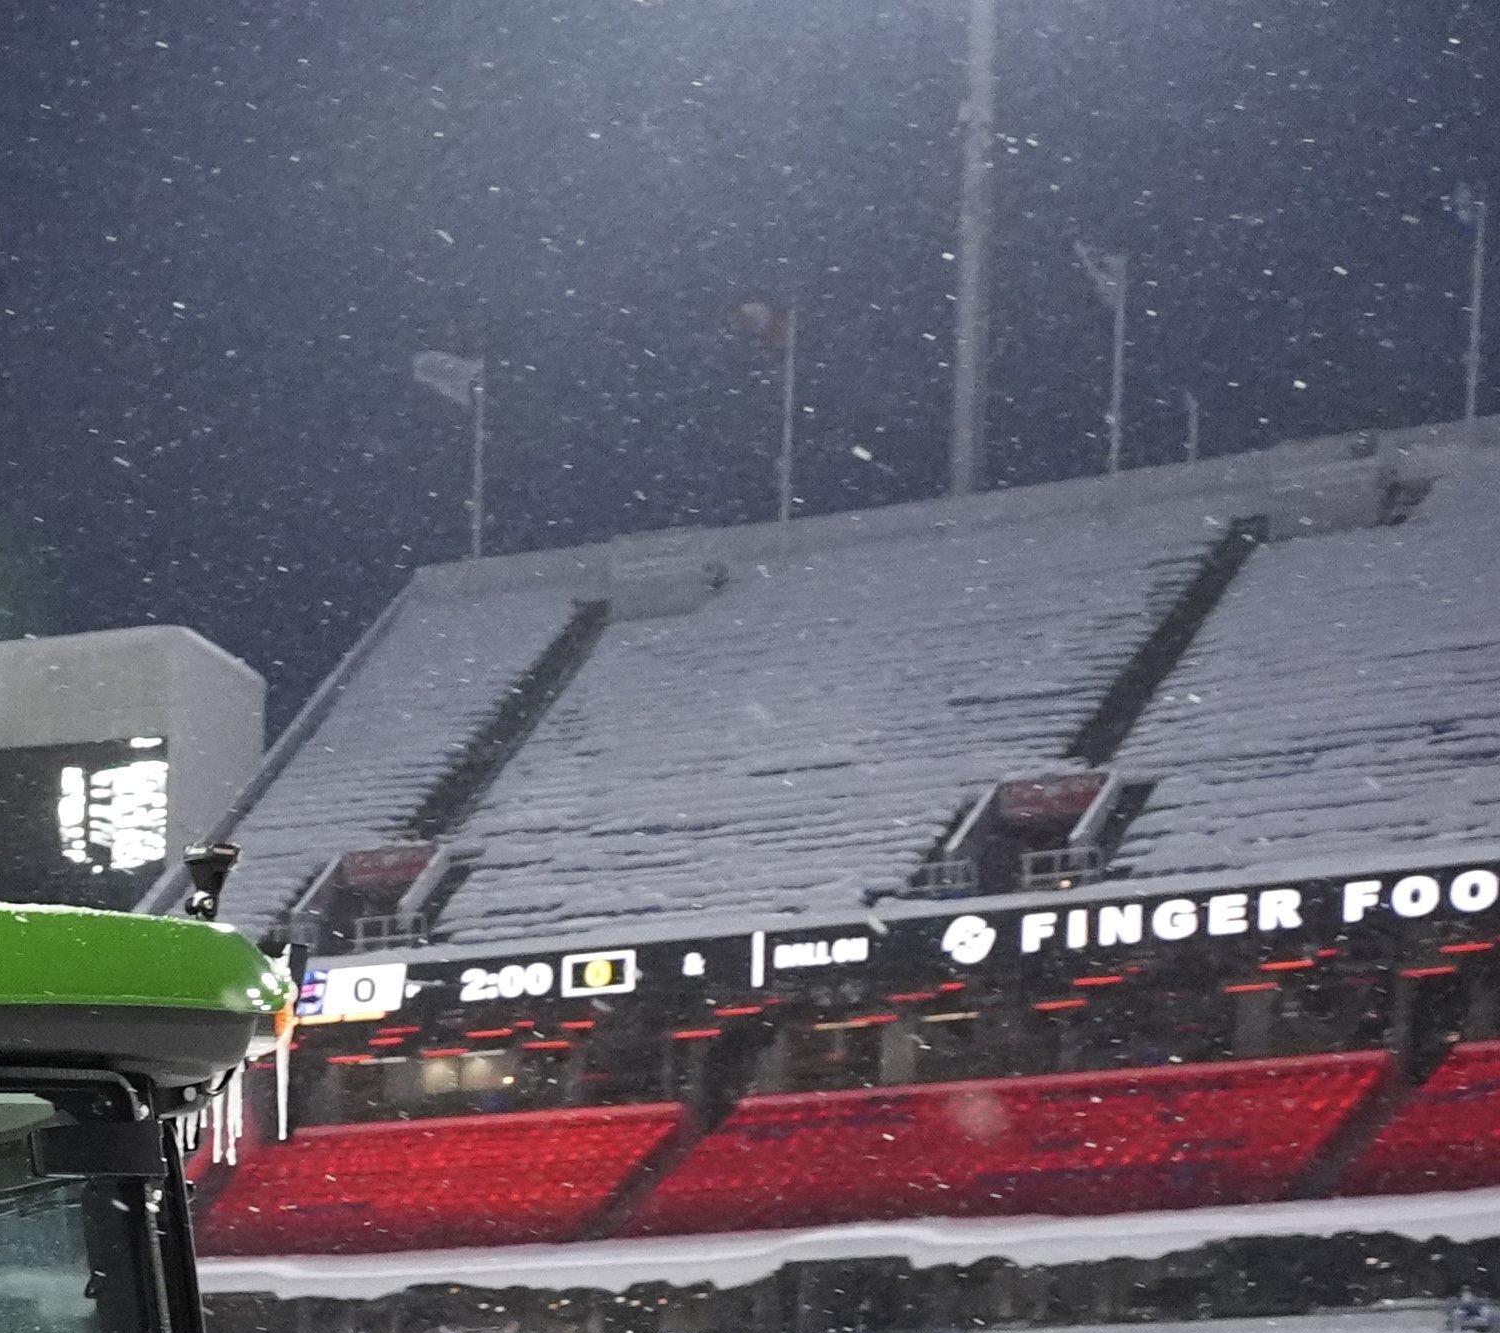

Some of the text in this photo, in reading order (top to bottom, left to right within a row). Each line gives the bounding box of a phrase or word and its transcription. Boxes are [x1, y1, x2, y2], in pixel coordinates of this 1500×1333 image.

[1021, 869, 1500, 953] FINGER FOO
[353, 976, 377, 1004] 0
[460, 962, 553, 1002] 2:00
